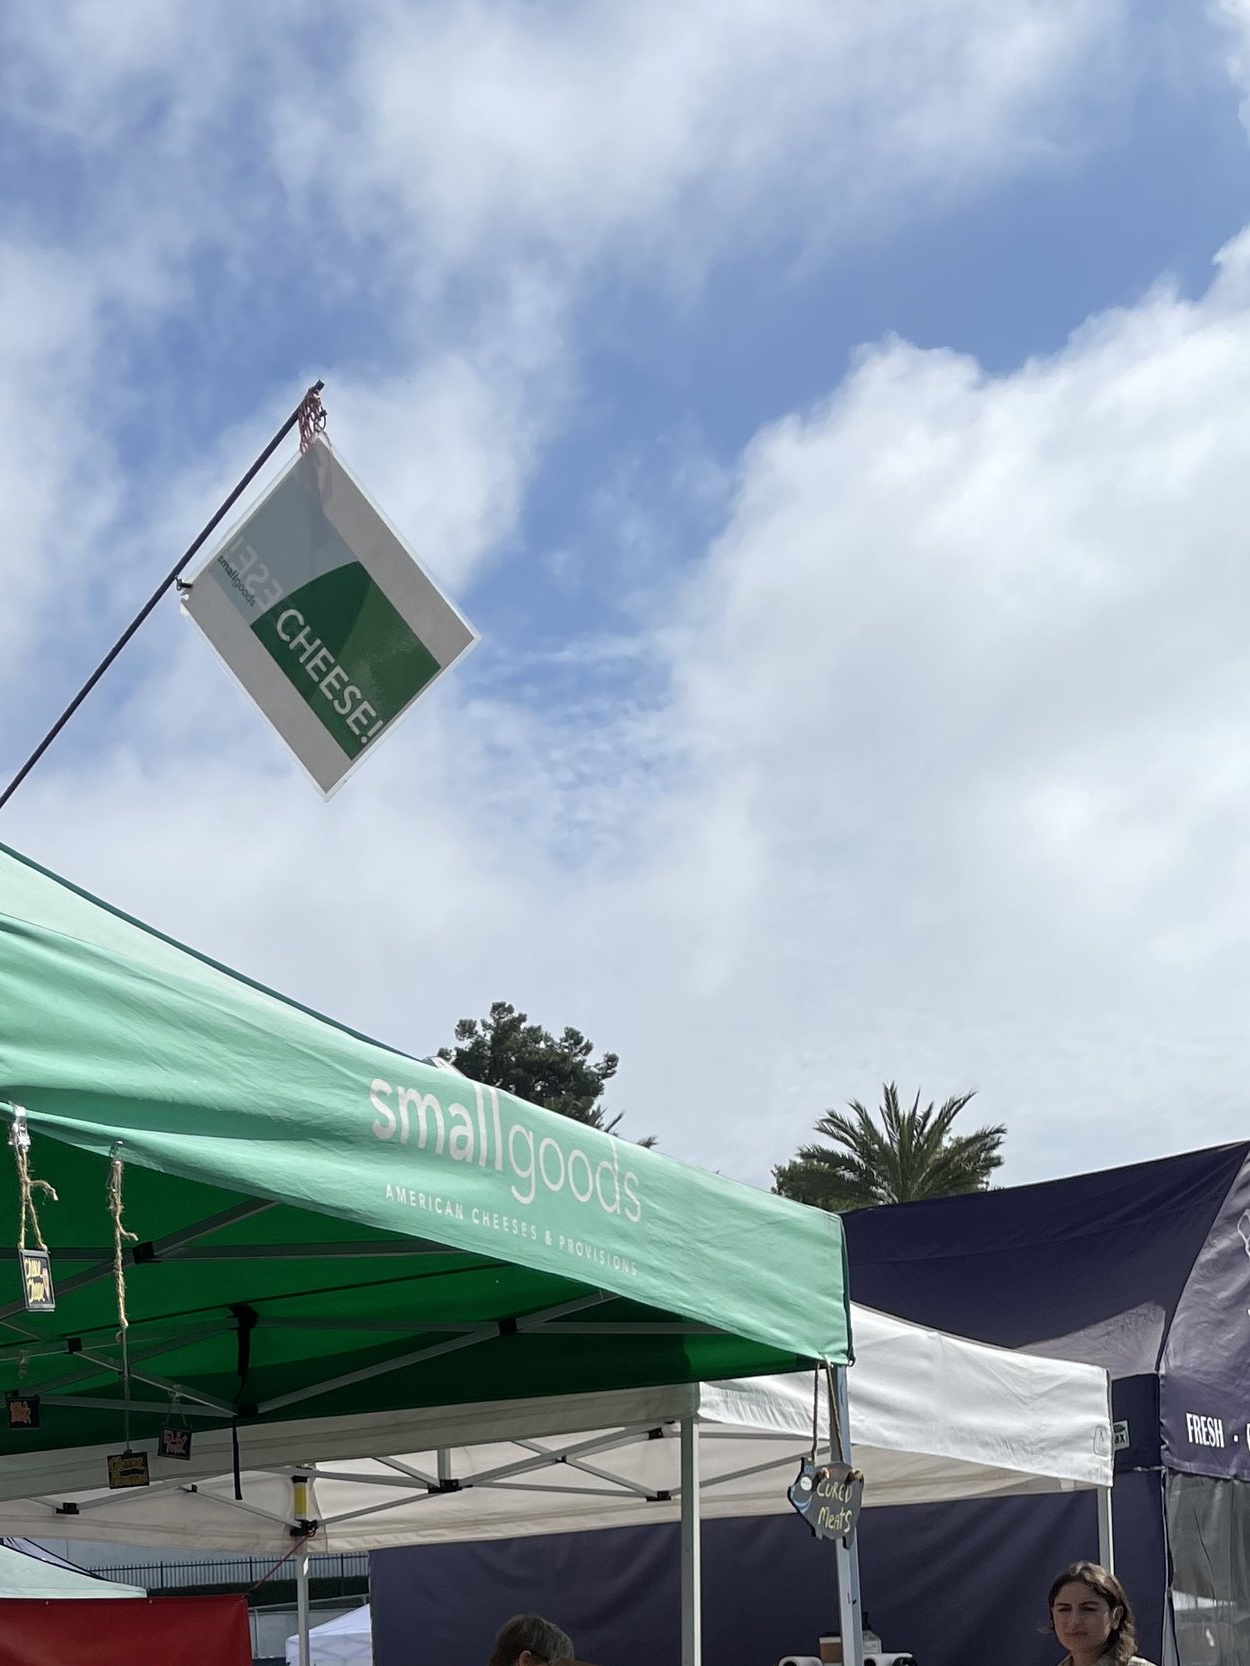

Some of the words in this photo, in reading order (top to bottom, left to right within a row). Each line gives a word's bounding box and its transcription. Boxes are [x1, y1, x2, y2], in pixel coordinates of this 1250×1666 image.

[217, 554, 257, 608] smallgoods
[276, 608, 384, 744] CHEESE!
[370, 1078, 642, 1223] smallgoods
[385, 1183, 464, 1221] AMERICAN
[471, 1208, 538, 1241] CHEESES
[544, 1230, 553, 1246] &
[558, 1236, 638, 1277] PROVISIONS
[1185, 1411, 1226, 1449] FRESH
